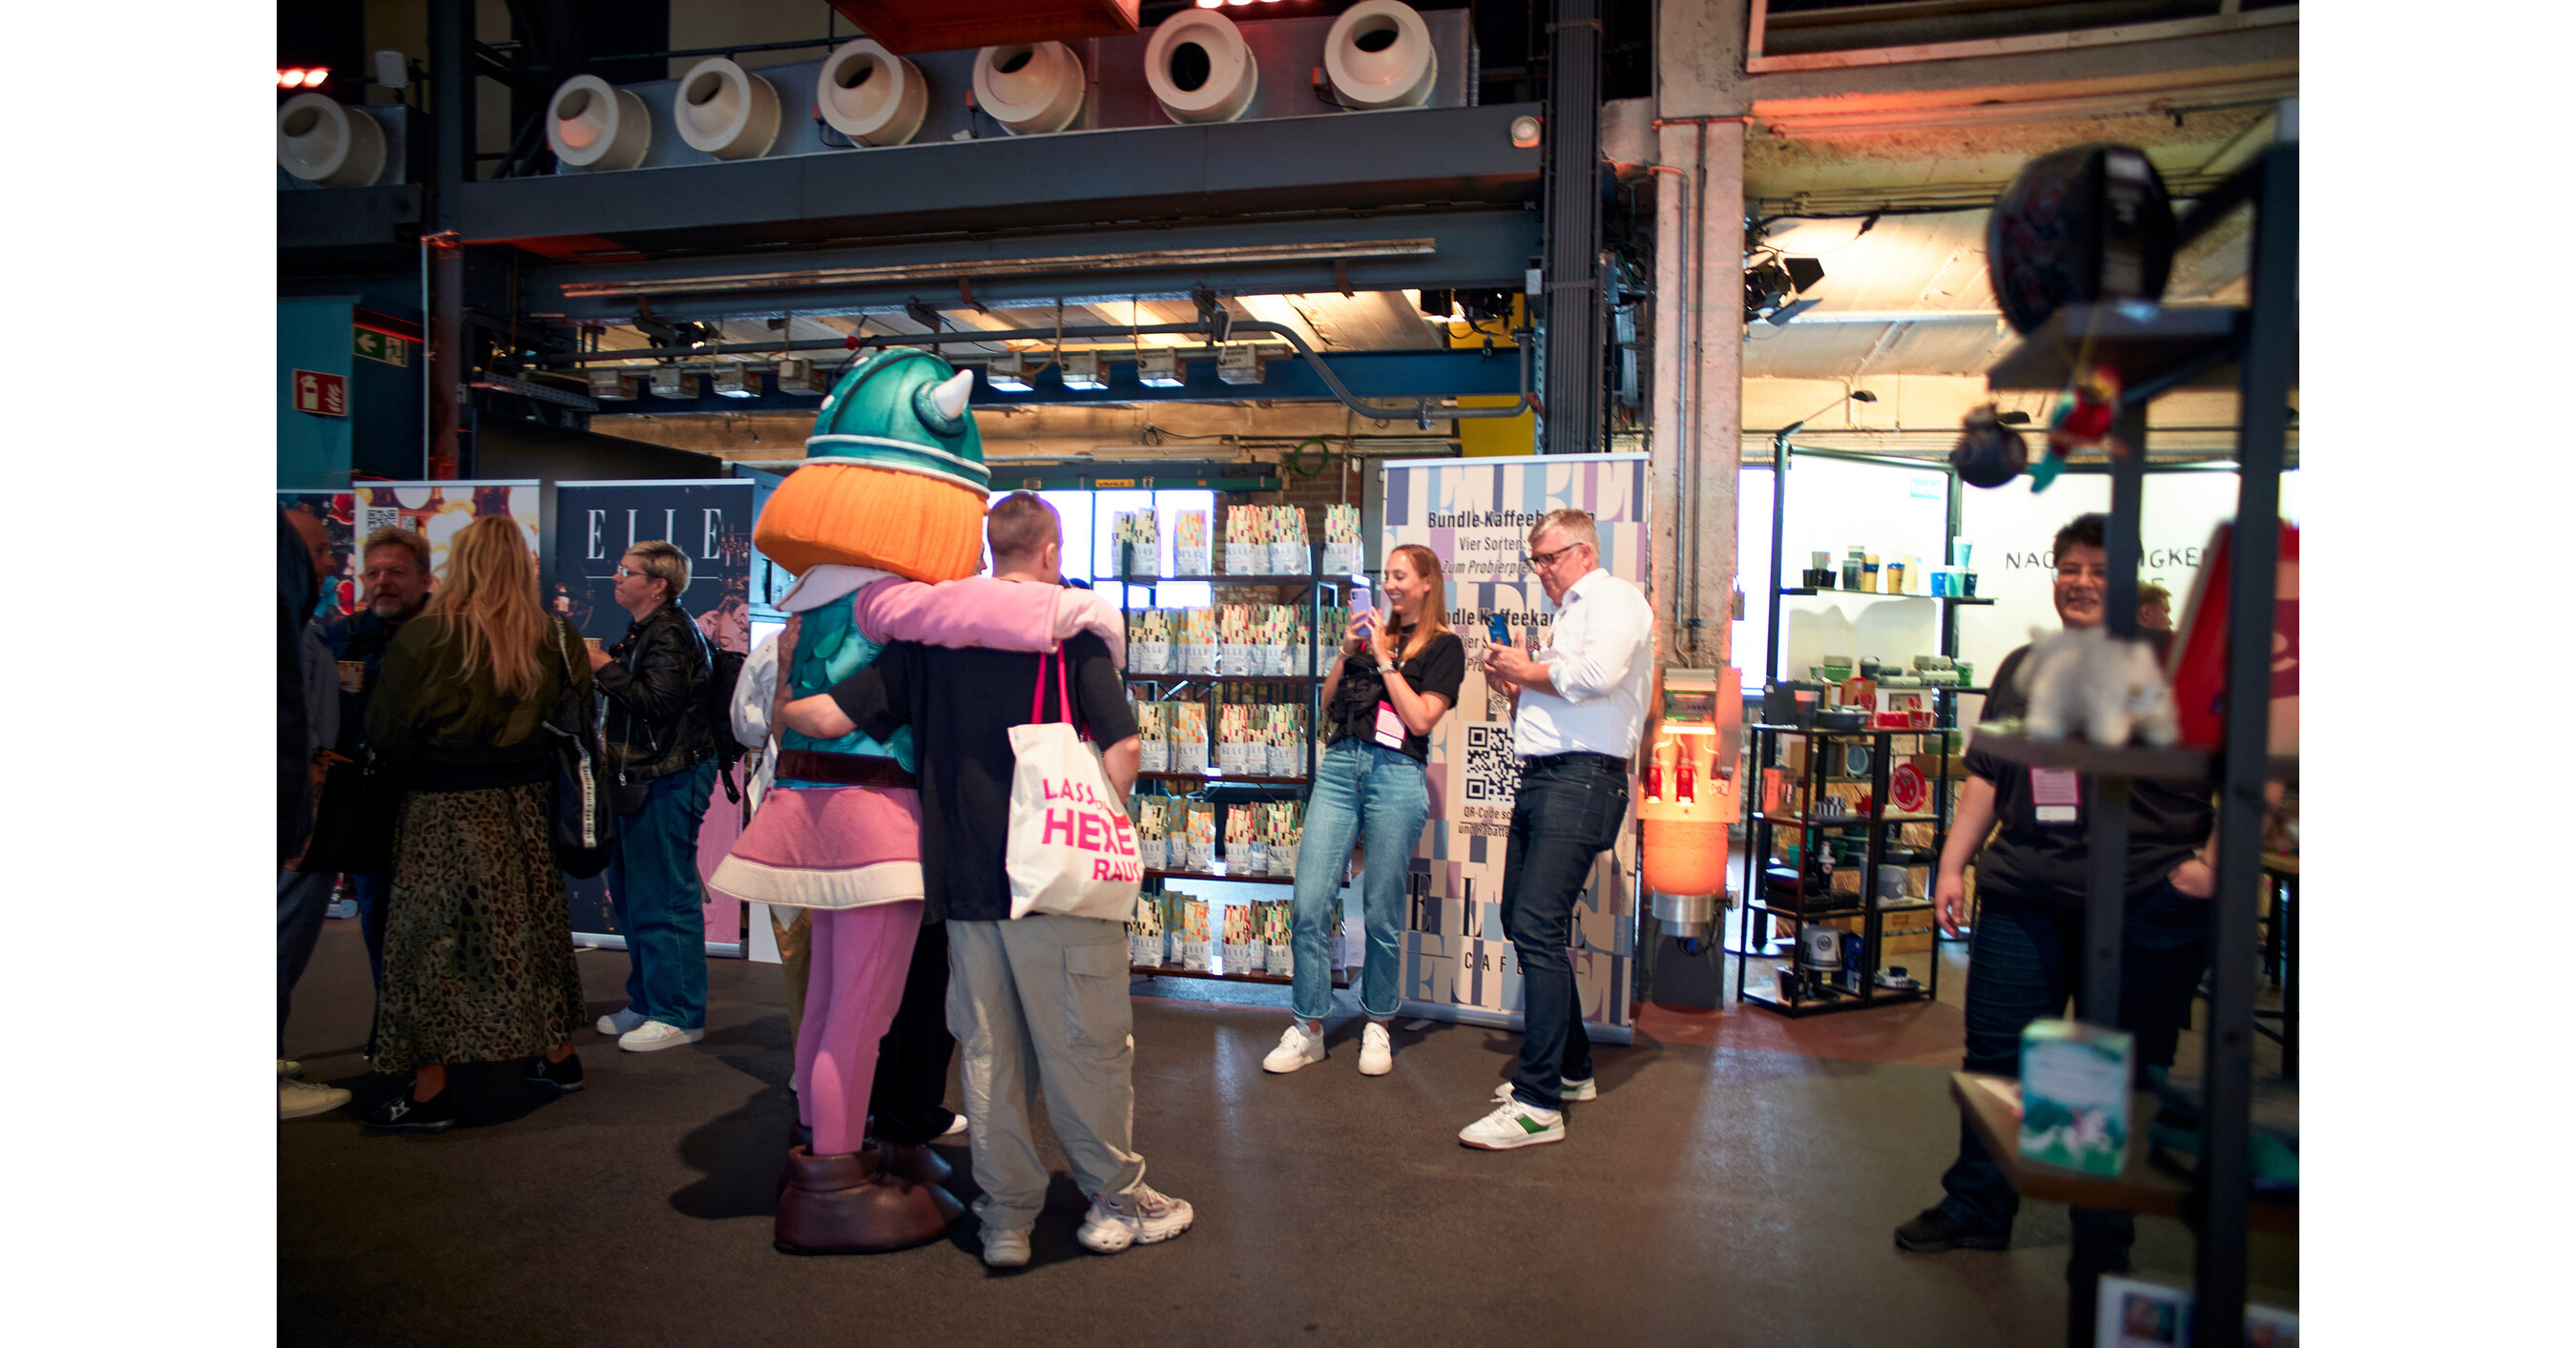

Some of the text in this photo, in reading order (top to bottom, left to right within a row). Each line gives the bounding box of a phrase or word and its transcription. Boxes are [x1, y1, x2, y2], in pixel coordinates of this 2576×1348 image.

[1428, 510, 1479, 529] Bundle
[586, 508, 722, 560] ELLE
[1459, 537, 1480, 551] Vier
[1443, 559, 1465, 573] Zum
[1042, 778, 1094, 805] LASS
[1041, 808, 1135, 857] HEXE
[1092, 857, 1141, 882] RAUS
